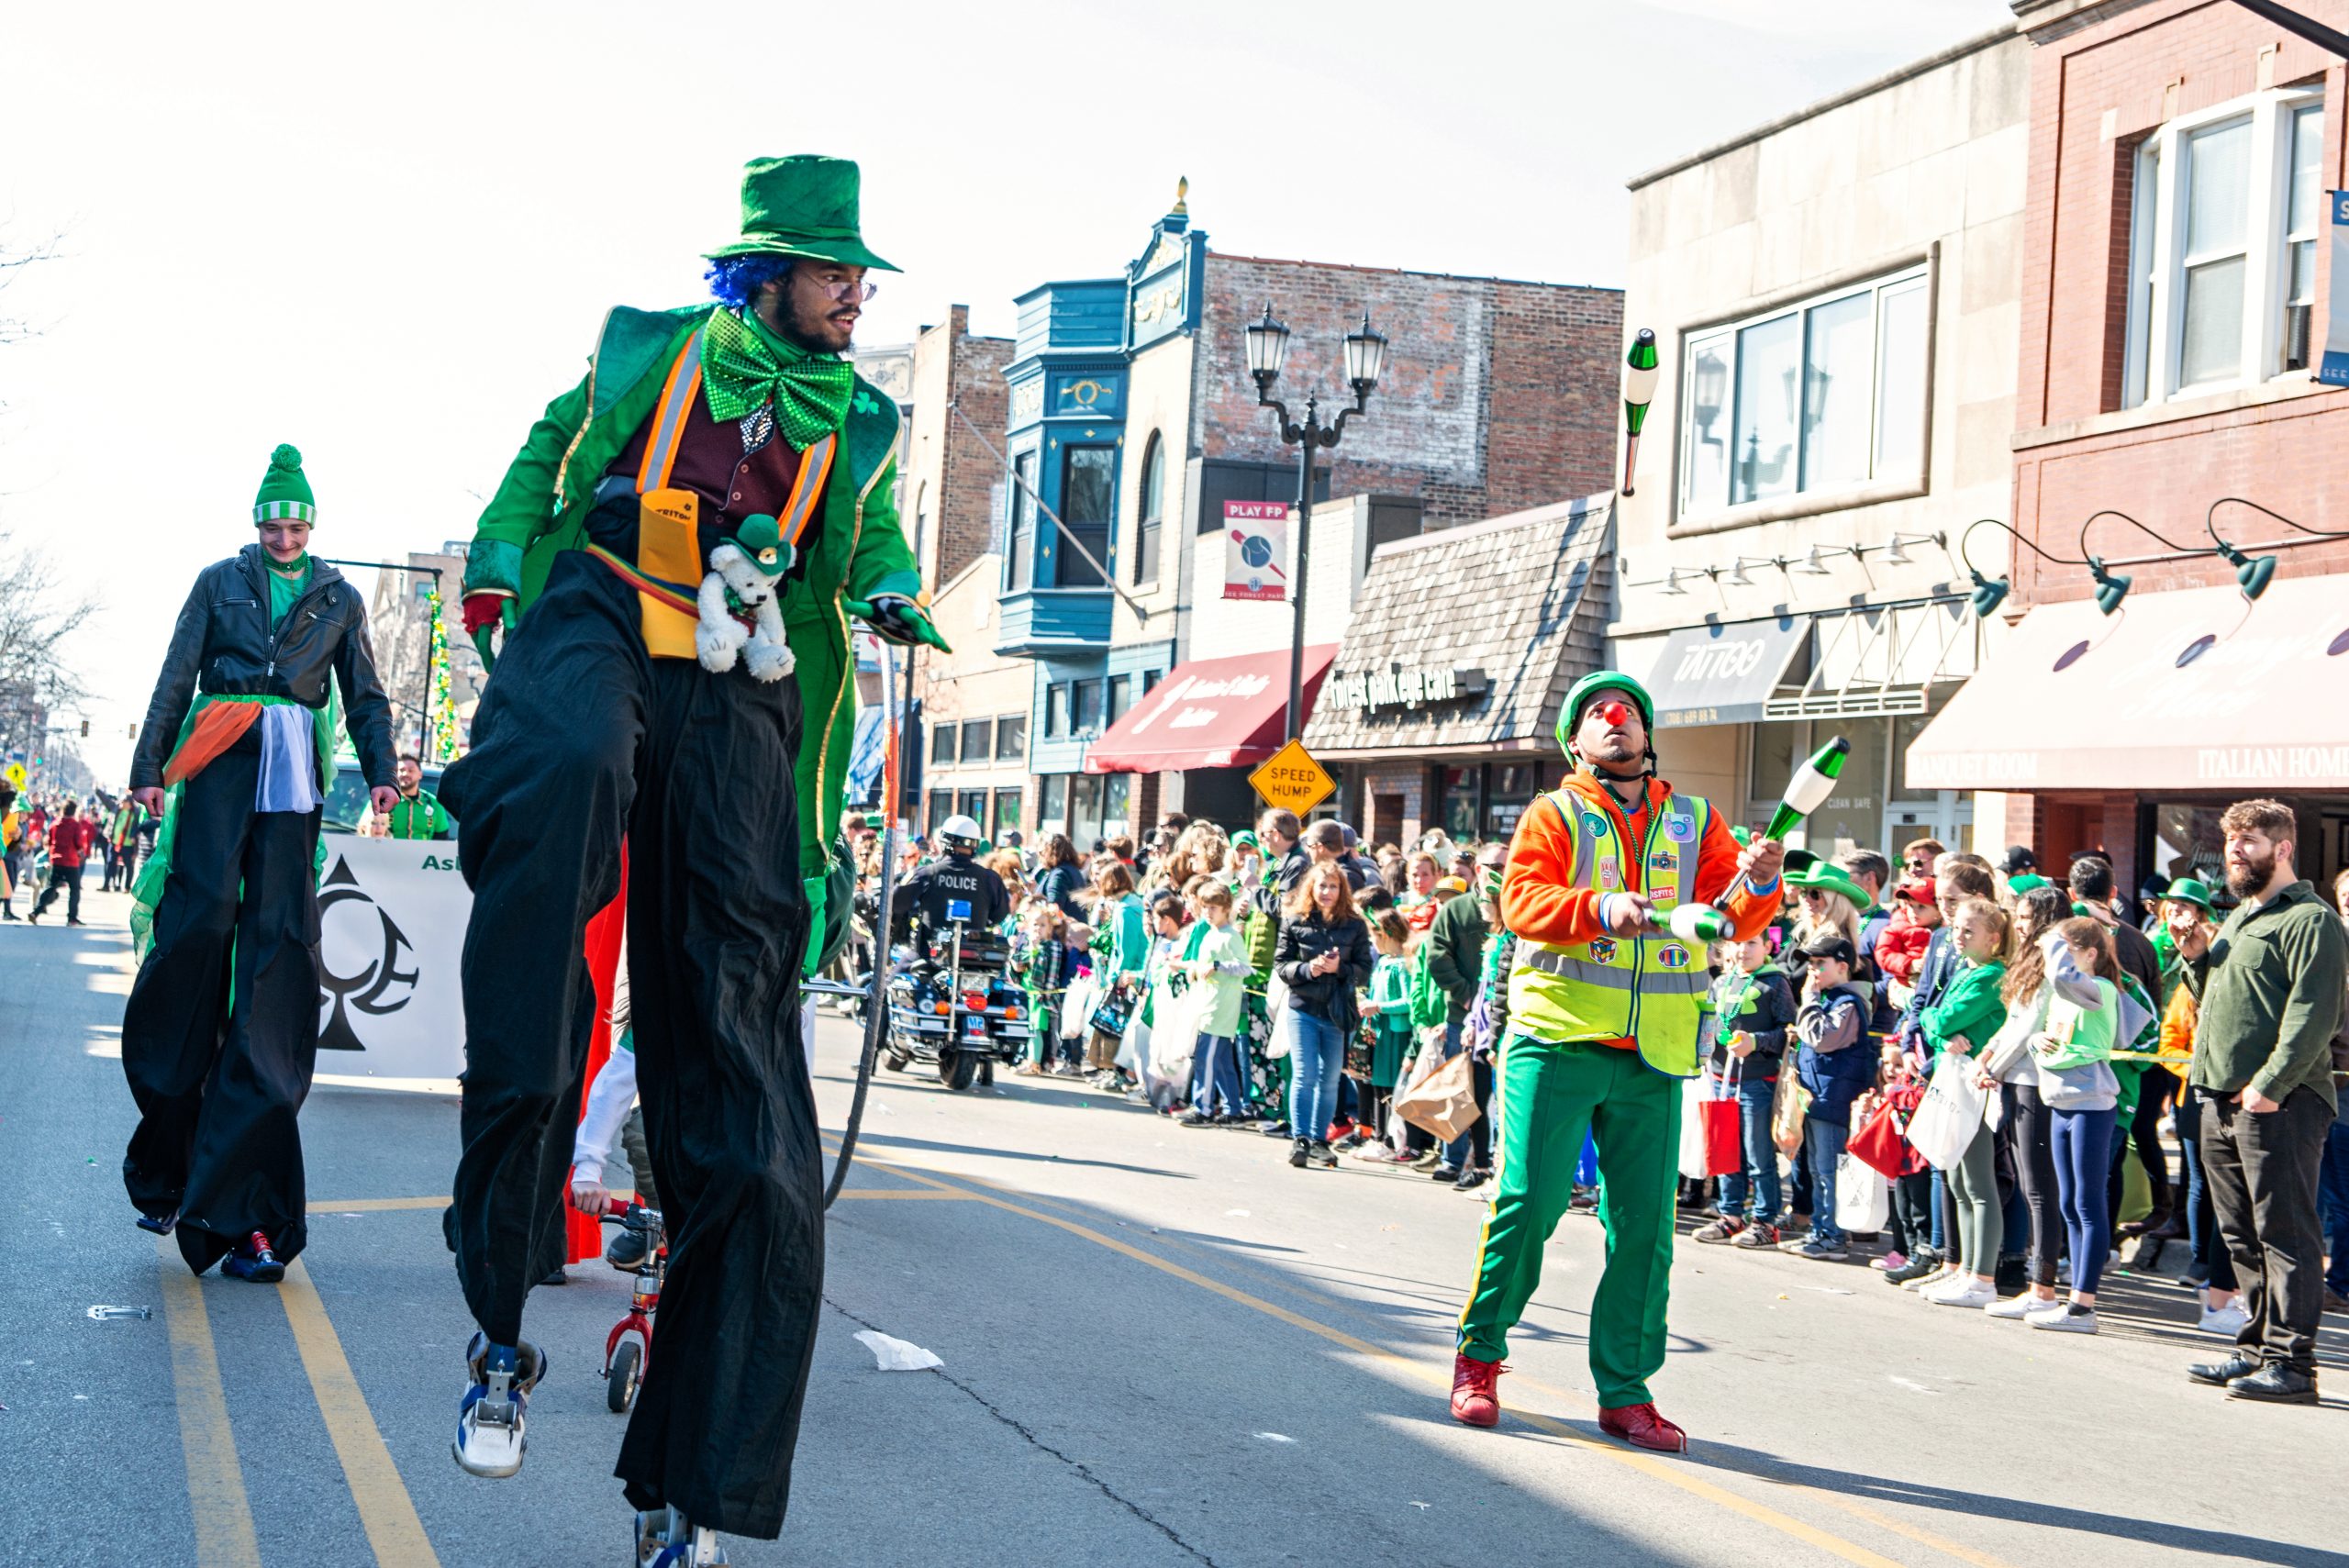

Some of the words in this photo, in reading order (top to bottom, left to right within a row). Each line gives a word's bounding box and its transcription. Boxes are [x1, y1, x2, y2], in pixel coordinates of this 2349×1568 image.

[1230, 505, 1262, 517] PLAY
[1266, 507, 1283, 517] FP
[1673, 639, 1766, 681] TATTOO
[1330, 669, 1368, 708] forest
[1368, 664, 1399, 714] park
[1397, 672, 1423, 709] eye
[1424, 668, 1456, 700] care
[1270, 767, 1316, 783] SPEED
[1907, 753, 1985, 784] BANQUET
[1987, 752, 2038, 780] ROOM
[2198, 749, 2284, 779] ITALIAN
[1272, 784, 1312, 798] HUMP
[938, 874, 978, 891] POLICE
